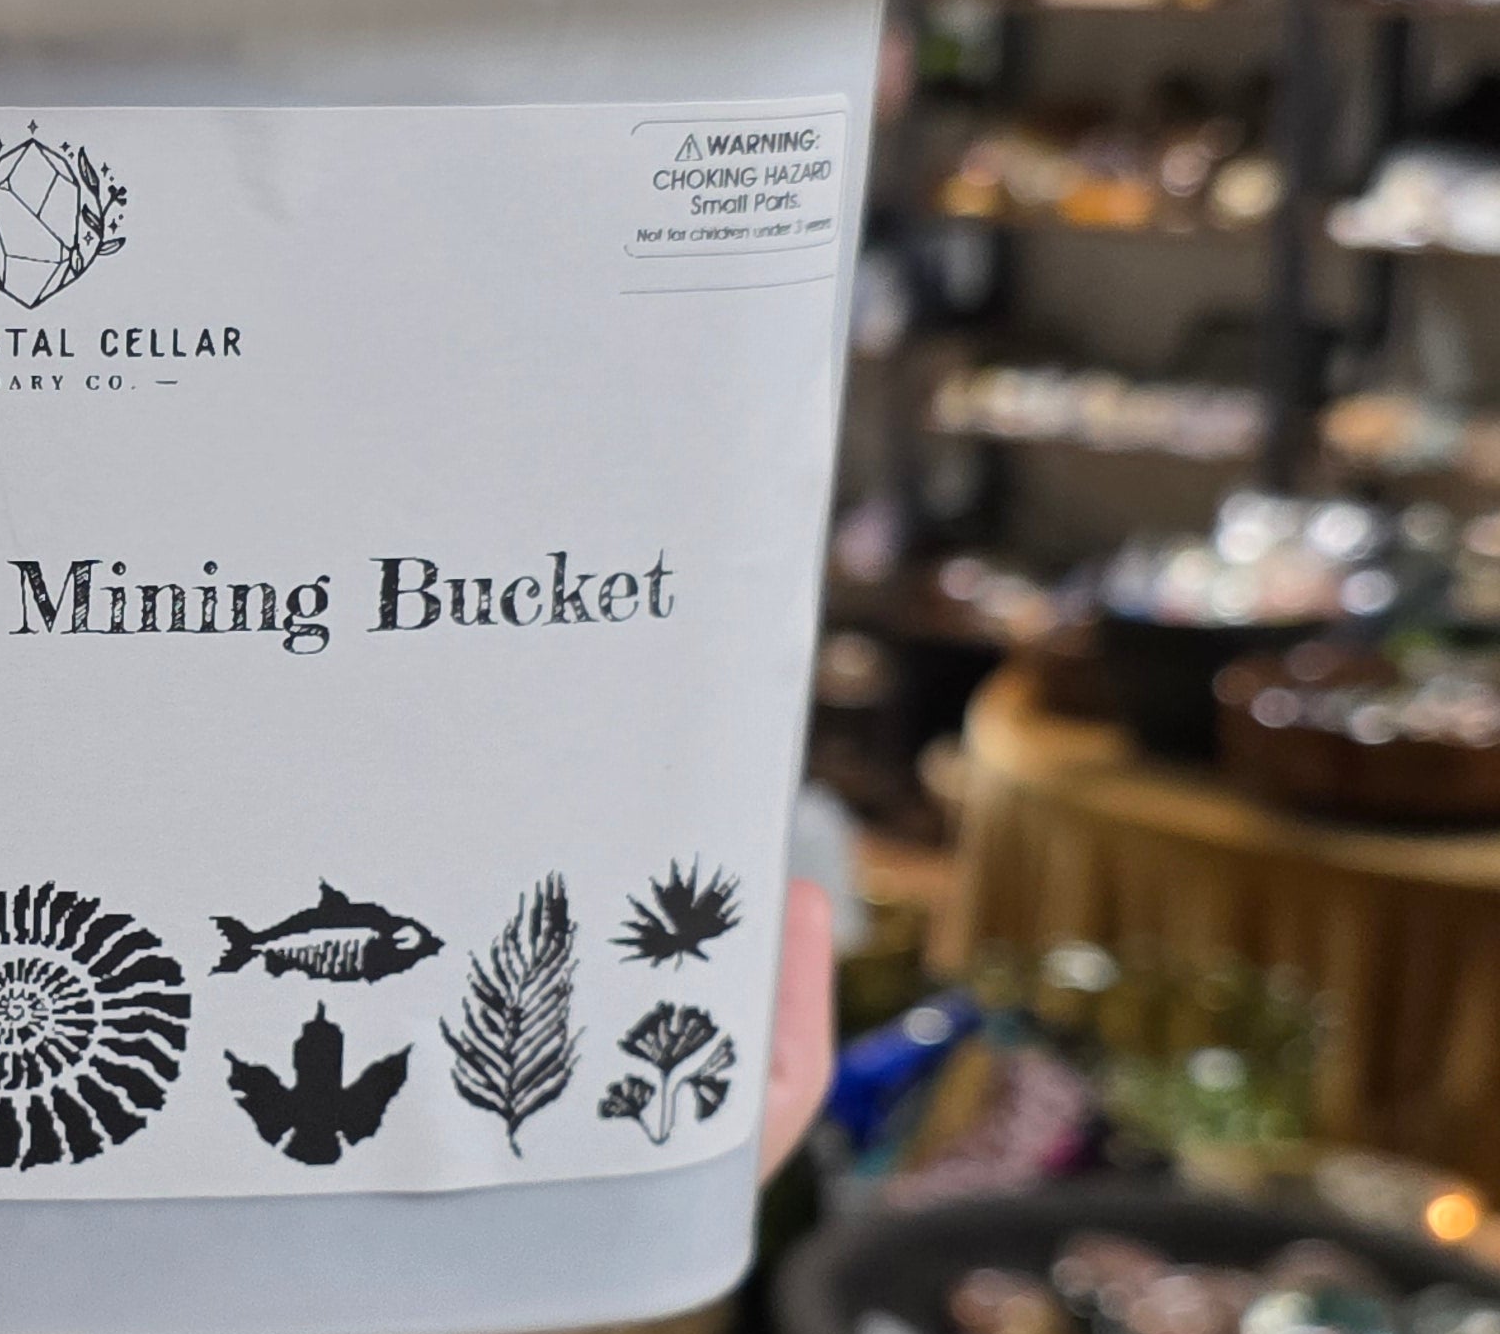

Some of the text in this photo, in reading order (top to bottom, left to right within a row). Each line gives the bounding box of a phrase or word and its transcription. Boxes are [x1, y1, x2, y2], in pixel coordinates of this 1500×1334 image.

[706, 128, 820, 156] WARNING:
[652, 159, 832, 191] CHOKING HAZARD
[690, 194, 748, 216] Small
[636, 229, 663, 243] Not
[667, 229, 687, 241] for
[690, 225, 750, 242] children
[99, 326, 242, 359] CELLAR
[85, 373, 138, 391] CO.
[6, 558, 331, 656] Mining
[366, 548, 676, 634] Bucket
